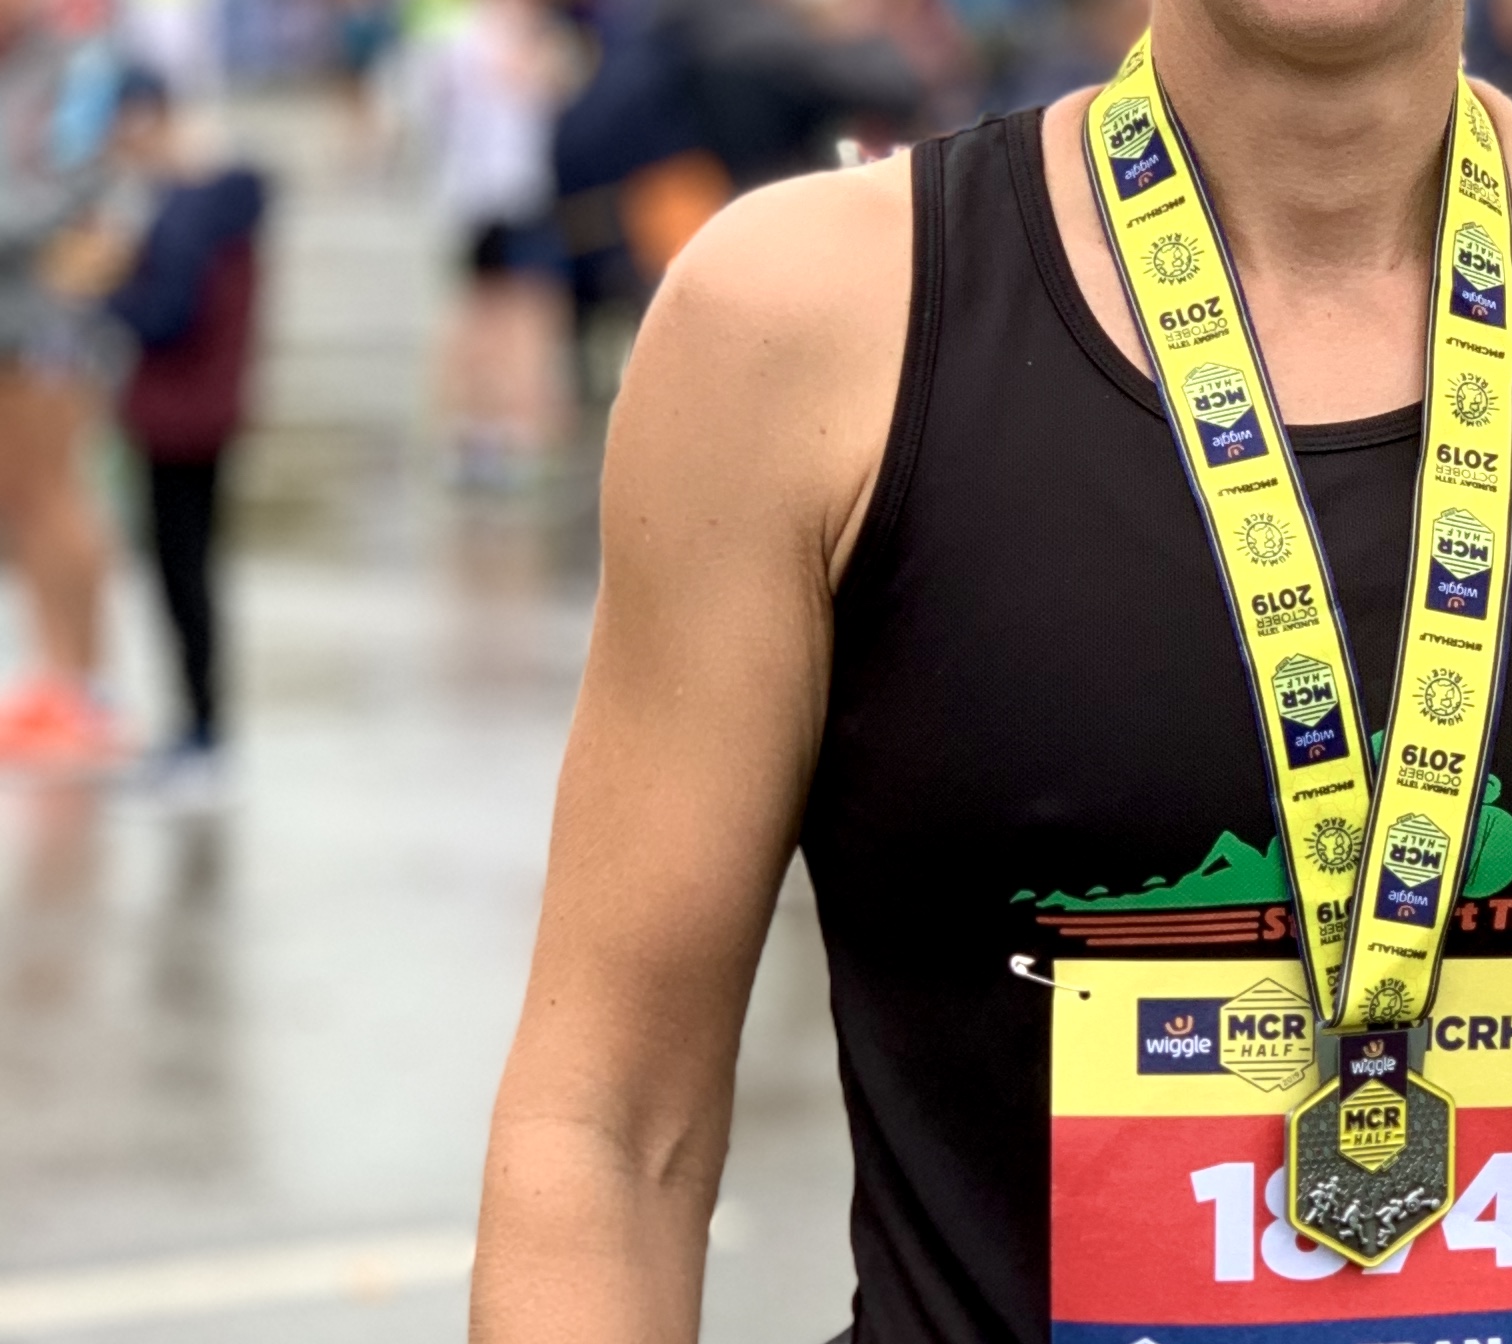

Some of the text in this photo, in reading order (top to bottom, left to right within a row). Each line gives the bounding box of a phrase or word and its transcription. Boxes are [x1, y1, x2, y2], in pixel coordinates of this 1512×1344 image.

[1113, 107, 1139, 132] HALF
[1109, 112, 1150, 149] MCR
[1125, 154, 1159, 180] wiggle
[1461, 157, 1499, 197] 2019
[1151, 232, 1182, 249] RACE
[1466, 242, 1494, 258] HALF
[1458, 247, 1501, 278] MCR
[1157, 265, 1200, 286] HUMAN
[1462, 290, 1497, 310] wiggle
[1159, 295, 1223, 331] 2019
[1164, 317, 1228, 342] OCTOBER
[1199, 378, 1232, 393] HALF
[1460, 373, 1489, 389] RACE
[1192, 387, 1247, 411] MCR
[1452, 408, 1491, 427] HUMAN
[1212, 430, 1253, 447] wiggle
[1437, 443, 1499, 472] 2019
[1435, 463, 1498, 484] OCTOBER
[1243, 512, 1274, 526] RACE
[1447, 528, 1480, 542] HALF
[1251, 549, 1293, 567] HUMAN
[1437, 536, 1489, 562] MCR
[1438, 581, 1479, 598] wiggle
[1251, 584, 1314, 616] 2019
[1256, 606, 1318, 628] OCTOBER
[1286, 673, 1320, 688] HALF
[1431, 668, 1463, 684] RACE
[1280, 682, 1333, 709] MCR
[1420, 707, 1464, 726] HUMAN
[1295, 729, 1335, 747] wiggle
[1401, 744, 1466, 775] 2019
[1398, 765, 1462, 787] OCTOBER
[1315, 817, 1346, 832] RACE
[1400, 834, 1436, 848] HALF
[1389, 843, 1443, 870] MCR
[1388, 890, 1428, 906] wiggle
[1227, 1013, 1307, 1041] MCR
[1146, 1035, 1212, 1058] wiggle
[1241, 1044, 1294, 1057] HALF
[1351, 1056, 1397, 1076] wiggle
[1344, 1106, 1401, 1132] MCR
[1354, 1131, 1393, 1145] HALF
